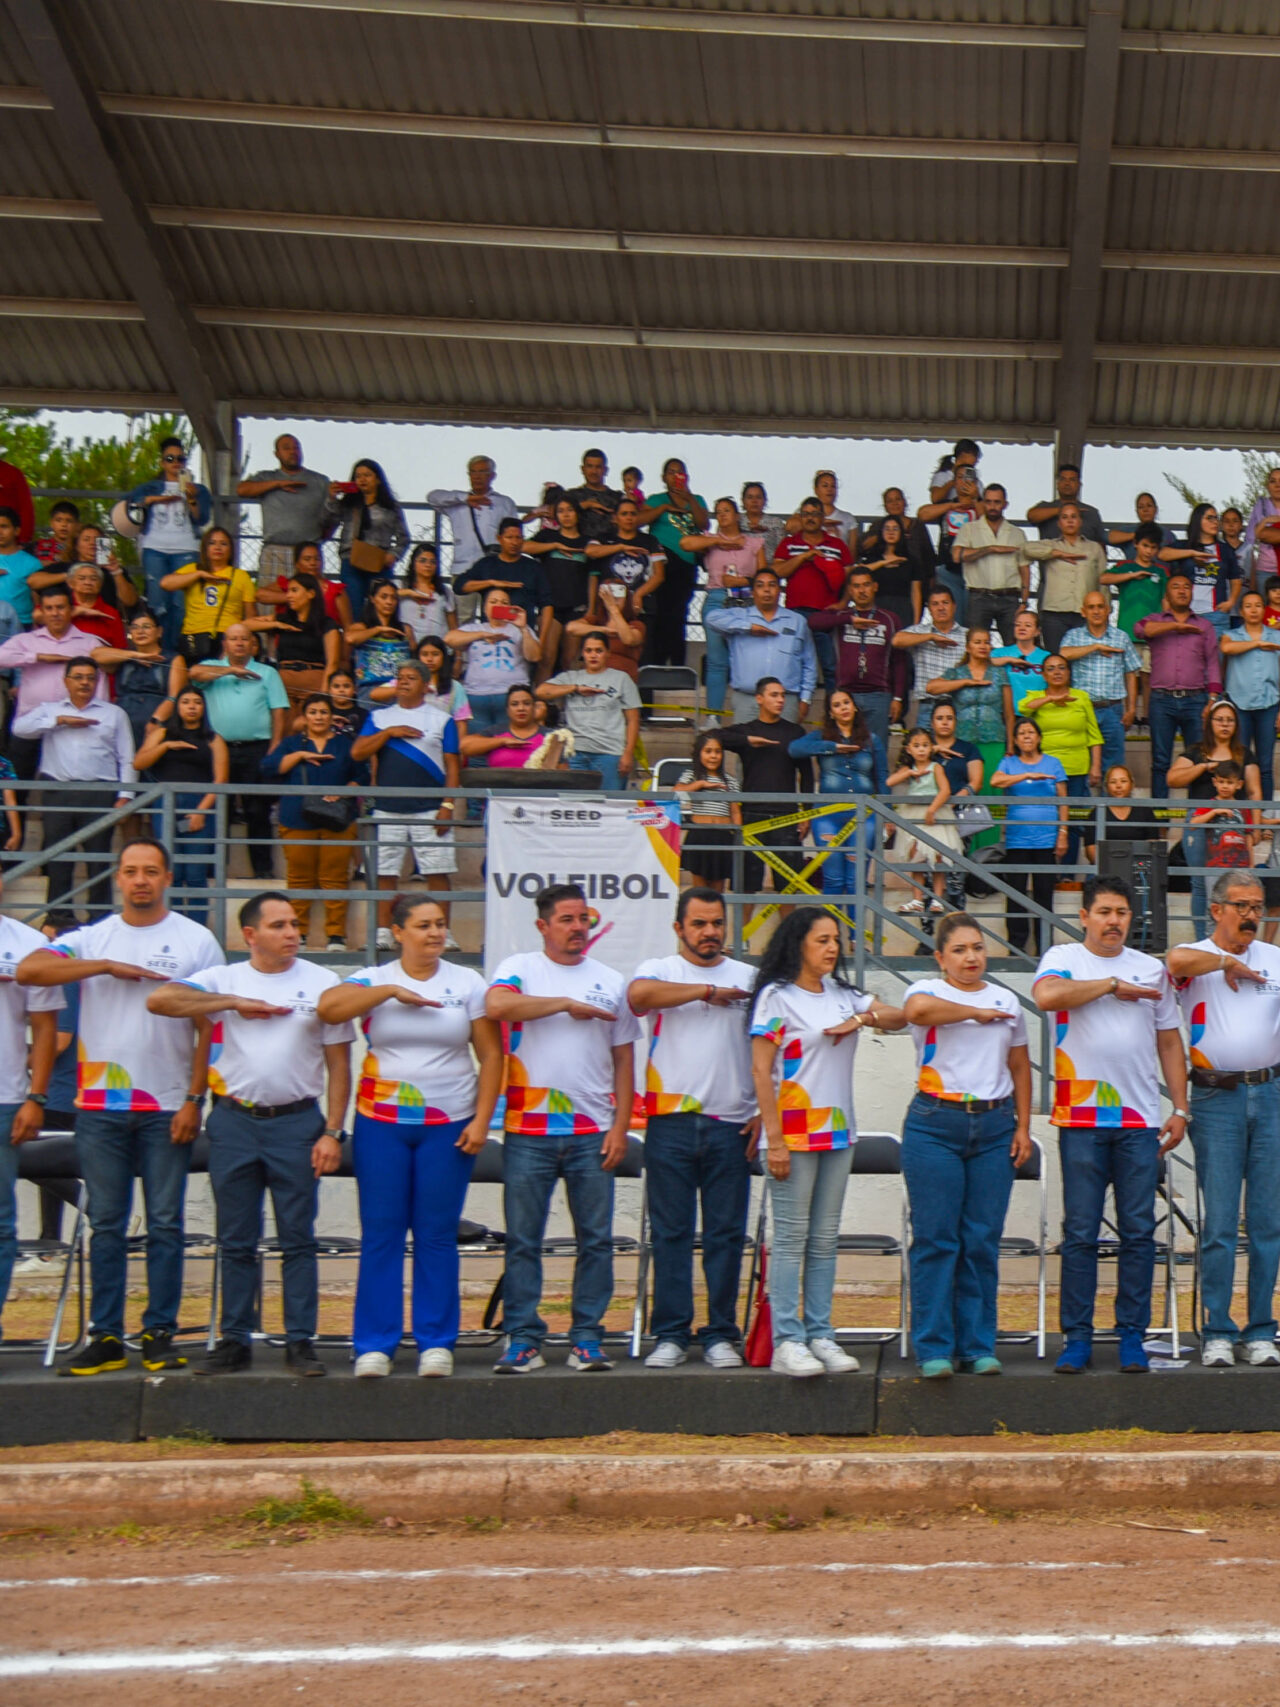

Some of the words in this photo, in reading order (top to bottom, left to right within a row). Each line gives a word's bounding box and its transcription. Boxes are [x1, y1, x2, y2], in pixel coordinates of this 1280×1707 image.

[204, 585, 218, 607] 6
[550, 809, 602, 820] SEED
[147, 960, 178, 969] SEED
[585, 995, 613, 1005] SEED
